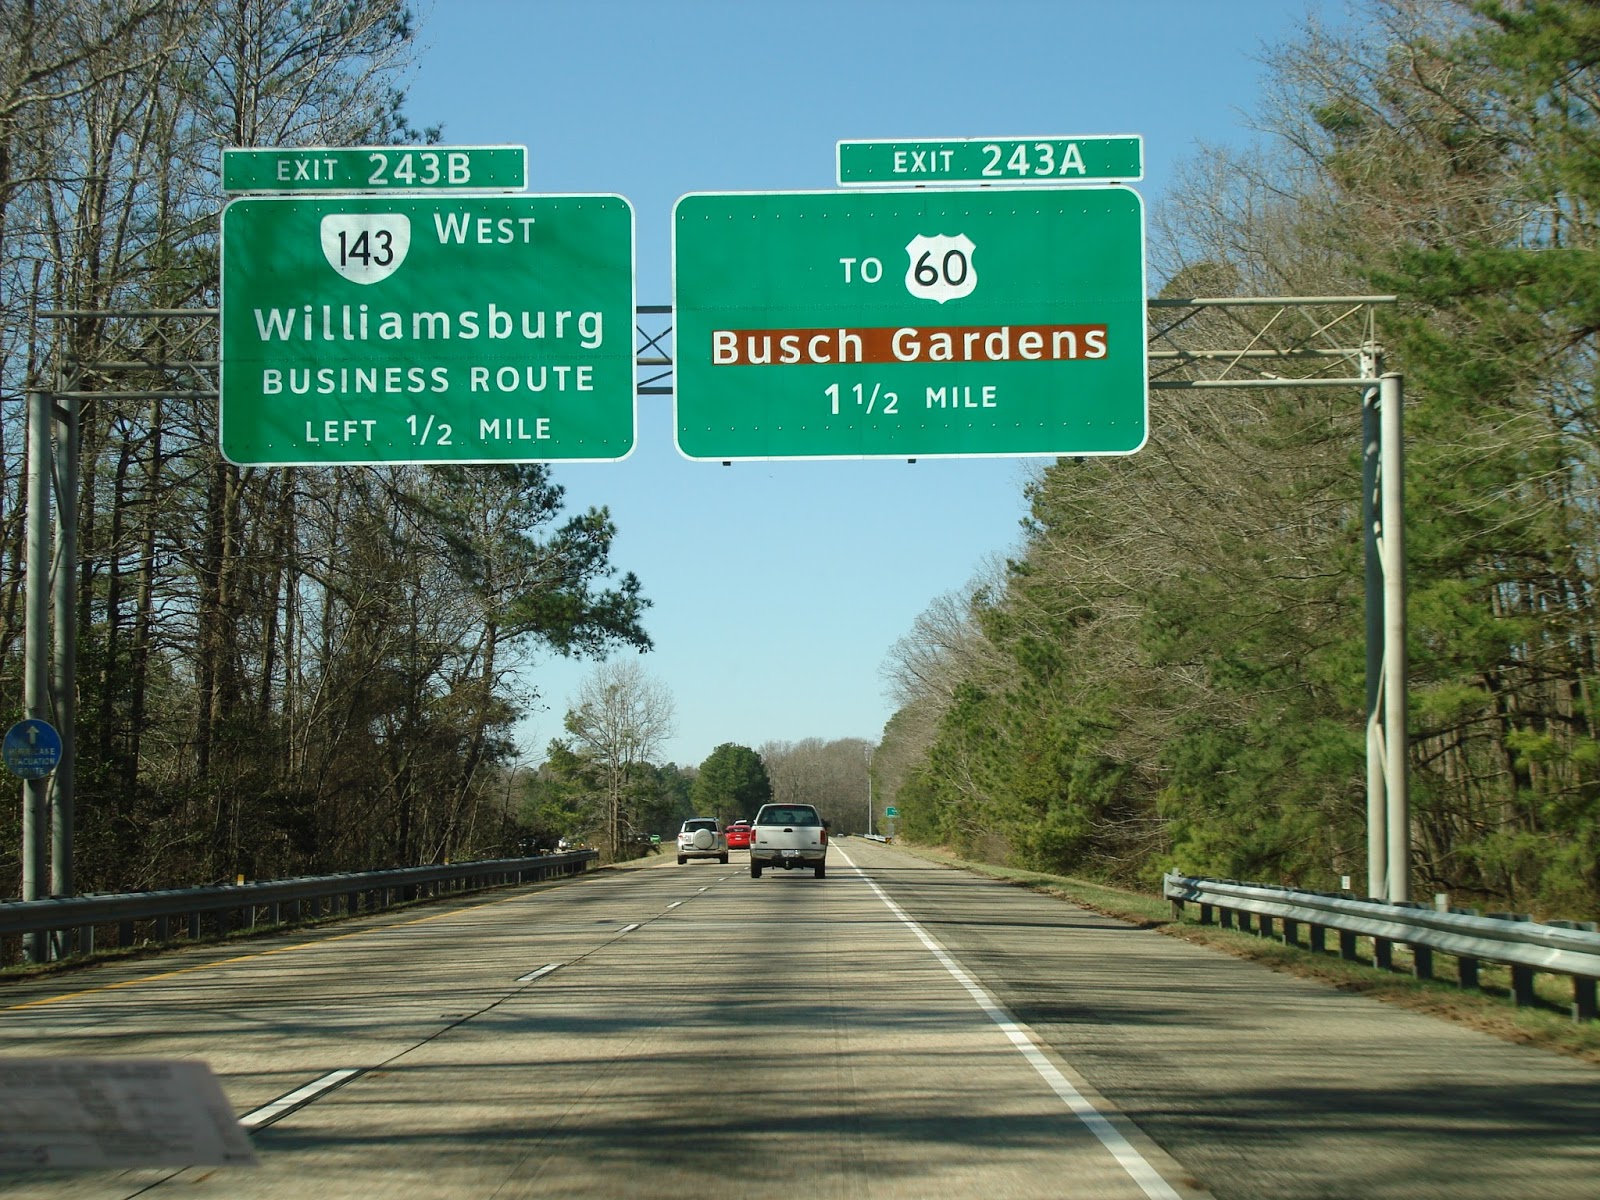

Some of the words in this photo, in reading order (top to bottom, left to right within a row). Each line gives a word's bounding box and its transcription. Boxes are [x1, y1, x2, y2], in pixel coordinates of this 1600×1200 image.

[277, 159, 338, 181] EXIT
[367, 152, 471, 185] 243B
[892, 150, 954, 173] EXIT
[981, 143, 1086, 176] 243A
[433, 212, 535, 244] WEST
[337, 229, 394, 267] 143
[839, 257, 883, 284] TO
[914, 249, 968, 287] 60
[254, 303, 603, 349] Williamsburg
[712, 328, 863, 365] Busch
[891, 326, 1107, 362] Gardens
[263, 367, 449, 395] BUSINESS
[470, 365, 594, 392] ROUTE
[926, 385, 997, 409] MILE
[306, 419, 377, 442] LEFT
[406, 414, 453, 446] 1/2
[479, 417, 551, 440] MILE
